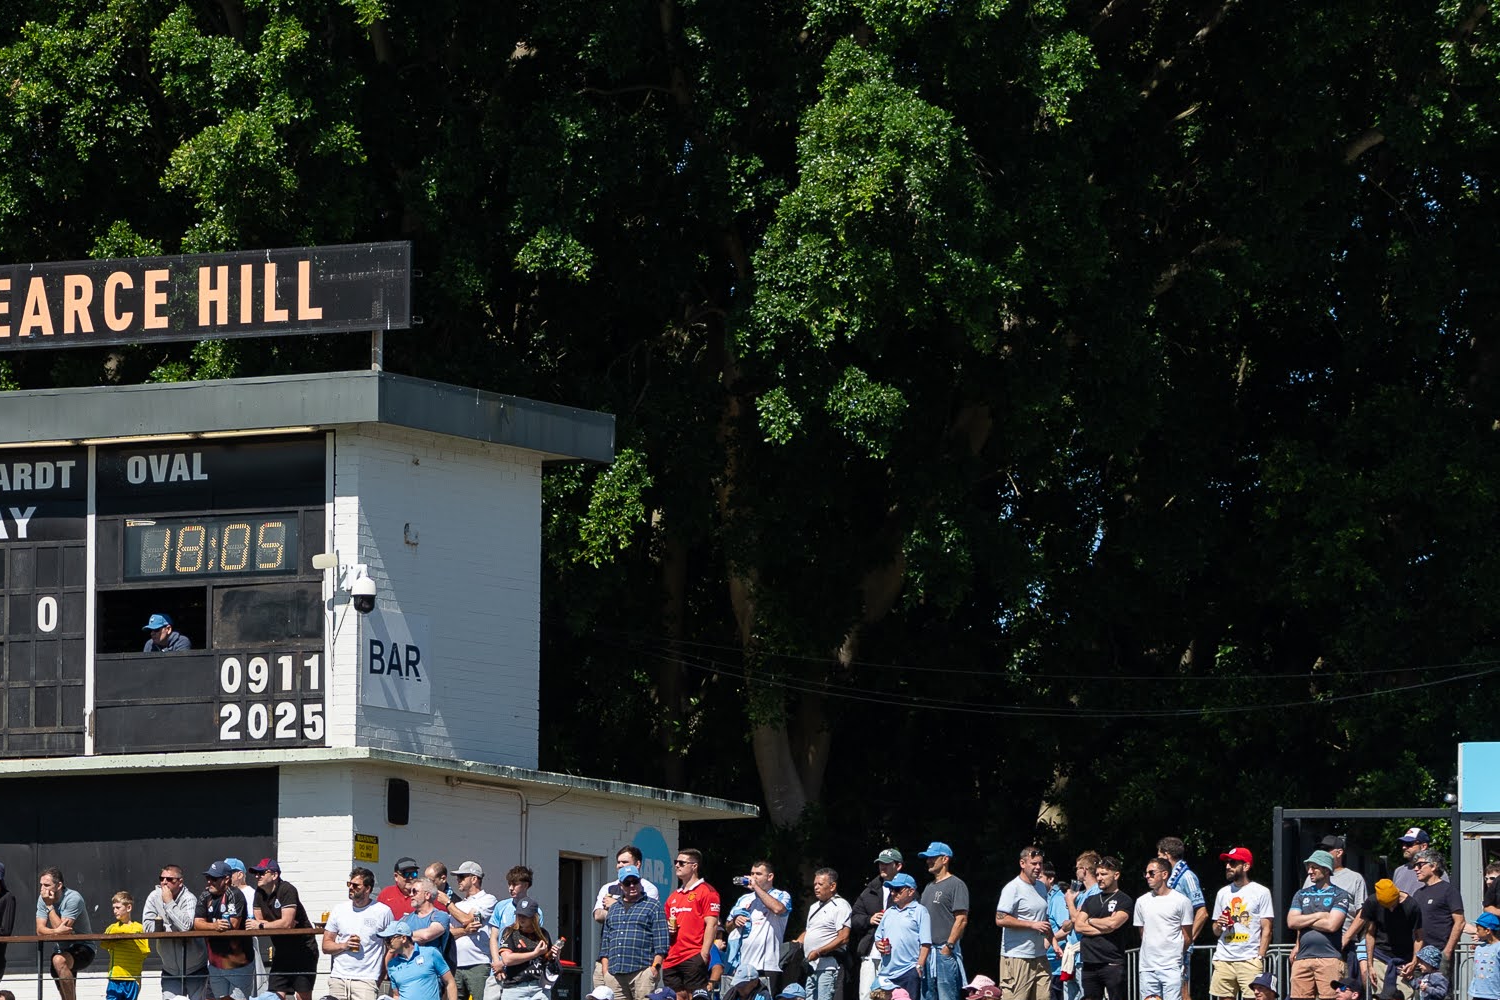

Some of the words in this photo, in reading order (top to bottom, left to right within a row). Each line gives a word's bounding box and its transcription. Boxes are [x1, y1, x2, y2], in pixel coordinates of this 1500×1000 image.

[198, 260, 323, 327] HILL
[127, 452, 208, 485] OVAL
[37, 596, 58, 633] 0
[369, 638, 422, 682] BAR
[220, 701, 325, 740] 2025
[642, 858, 668, 885] AR.
